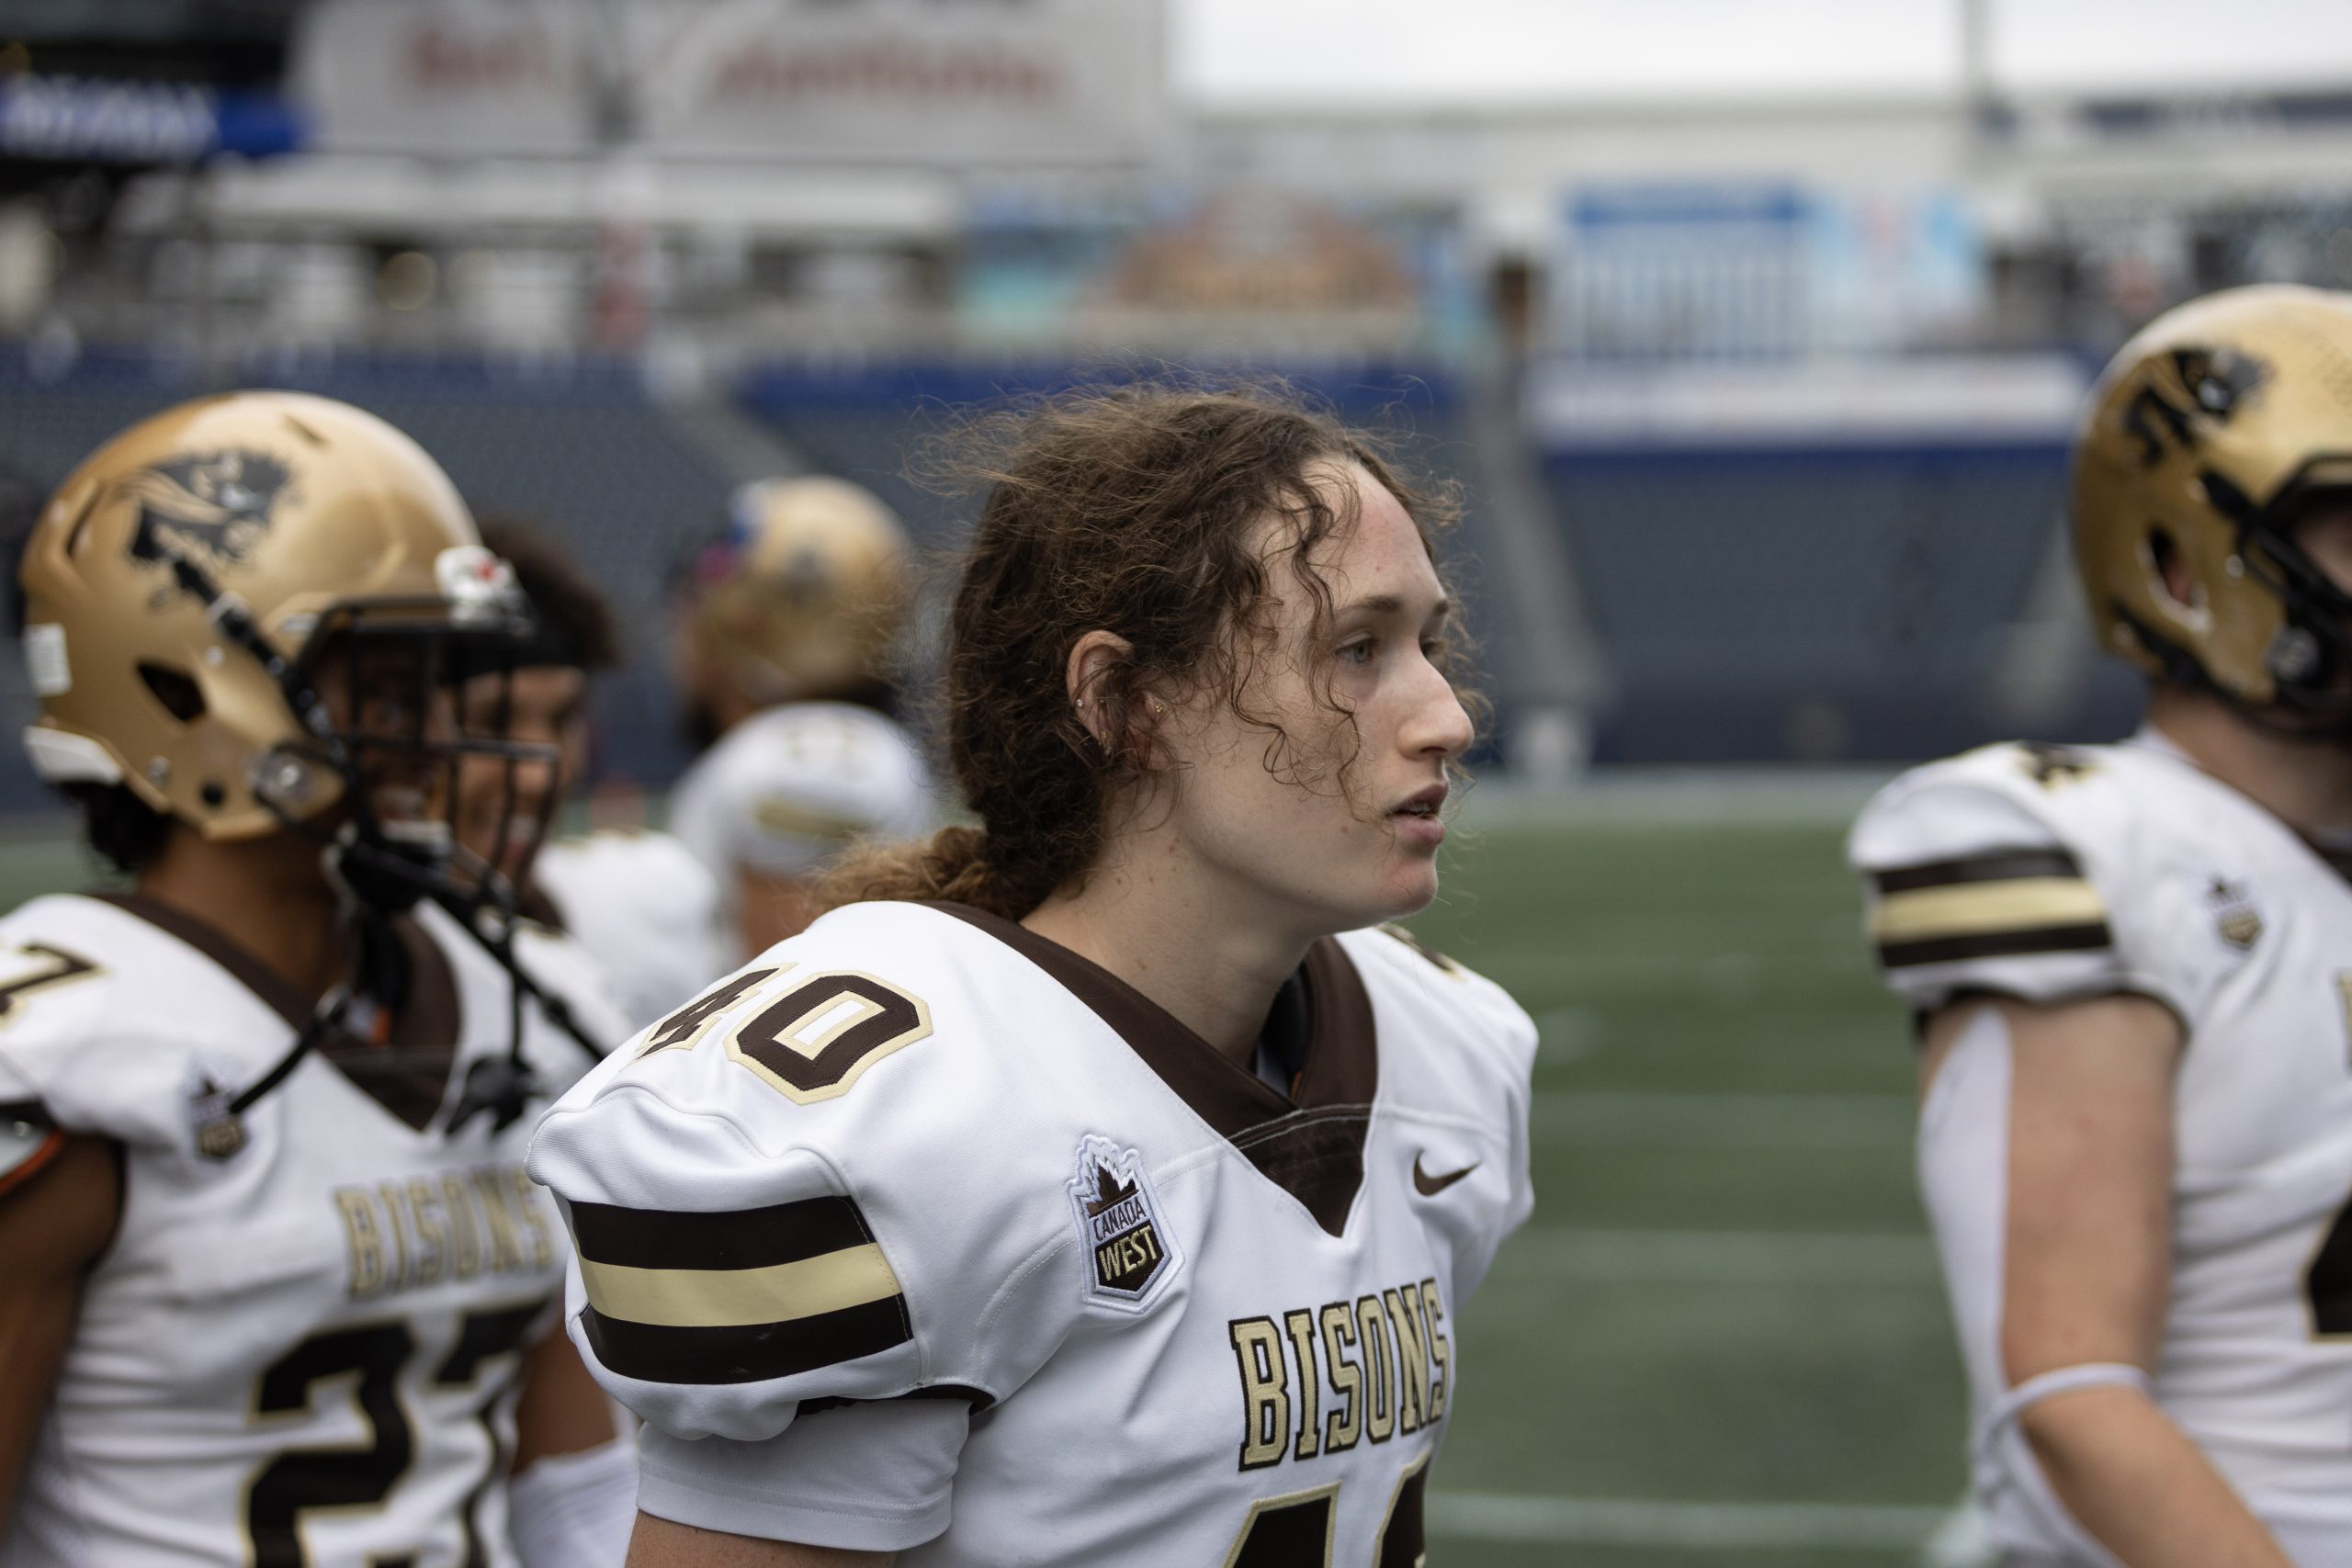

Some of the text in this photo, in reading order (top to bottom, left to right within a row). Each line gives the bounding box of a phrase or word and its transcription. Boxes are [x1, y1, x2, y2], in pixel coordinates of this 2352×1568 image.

[619, 962, 933, 1105] 40
[333, 1163, 555, 1300] BISONS
[1093, 1196, 1147, 1241] CANADA
[1099, 1225, 1158, 1281] WEST
[1228, 1278, 1450, 1472] BISONS
